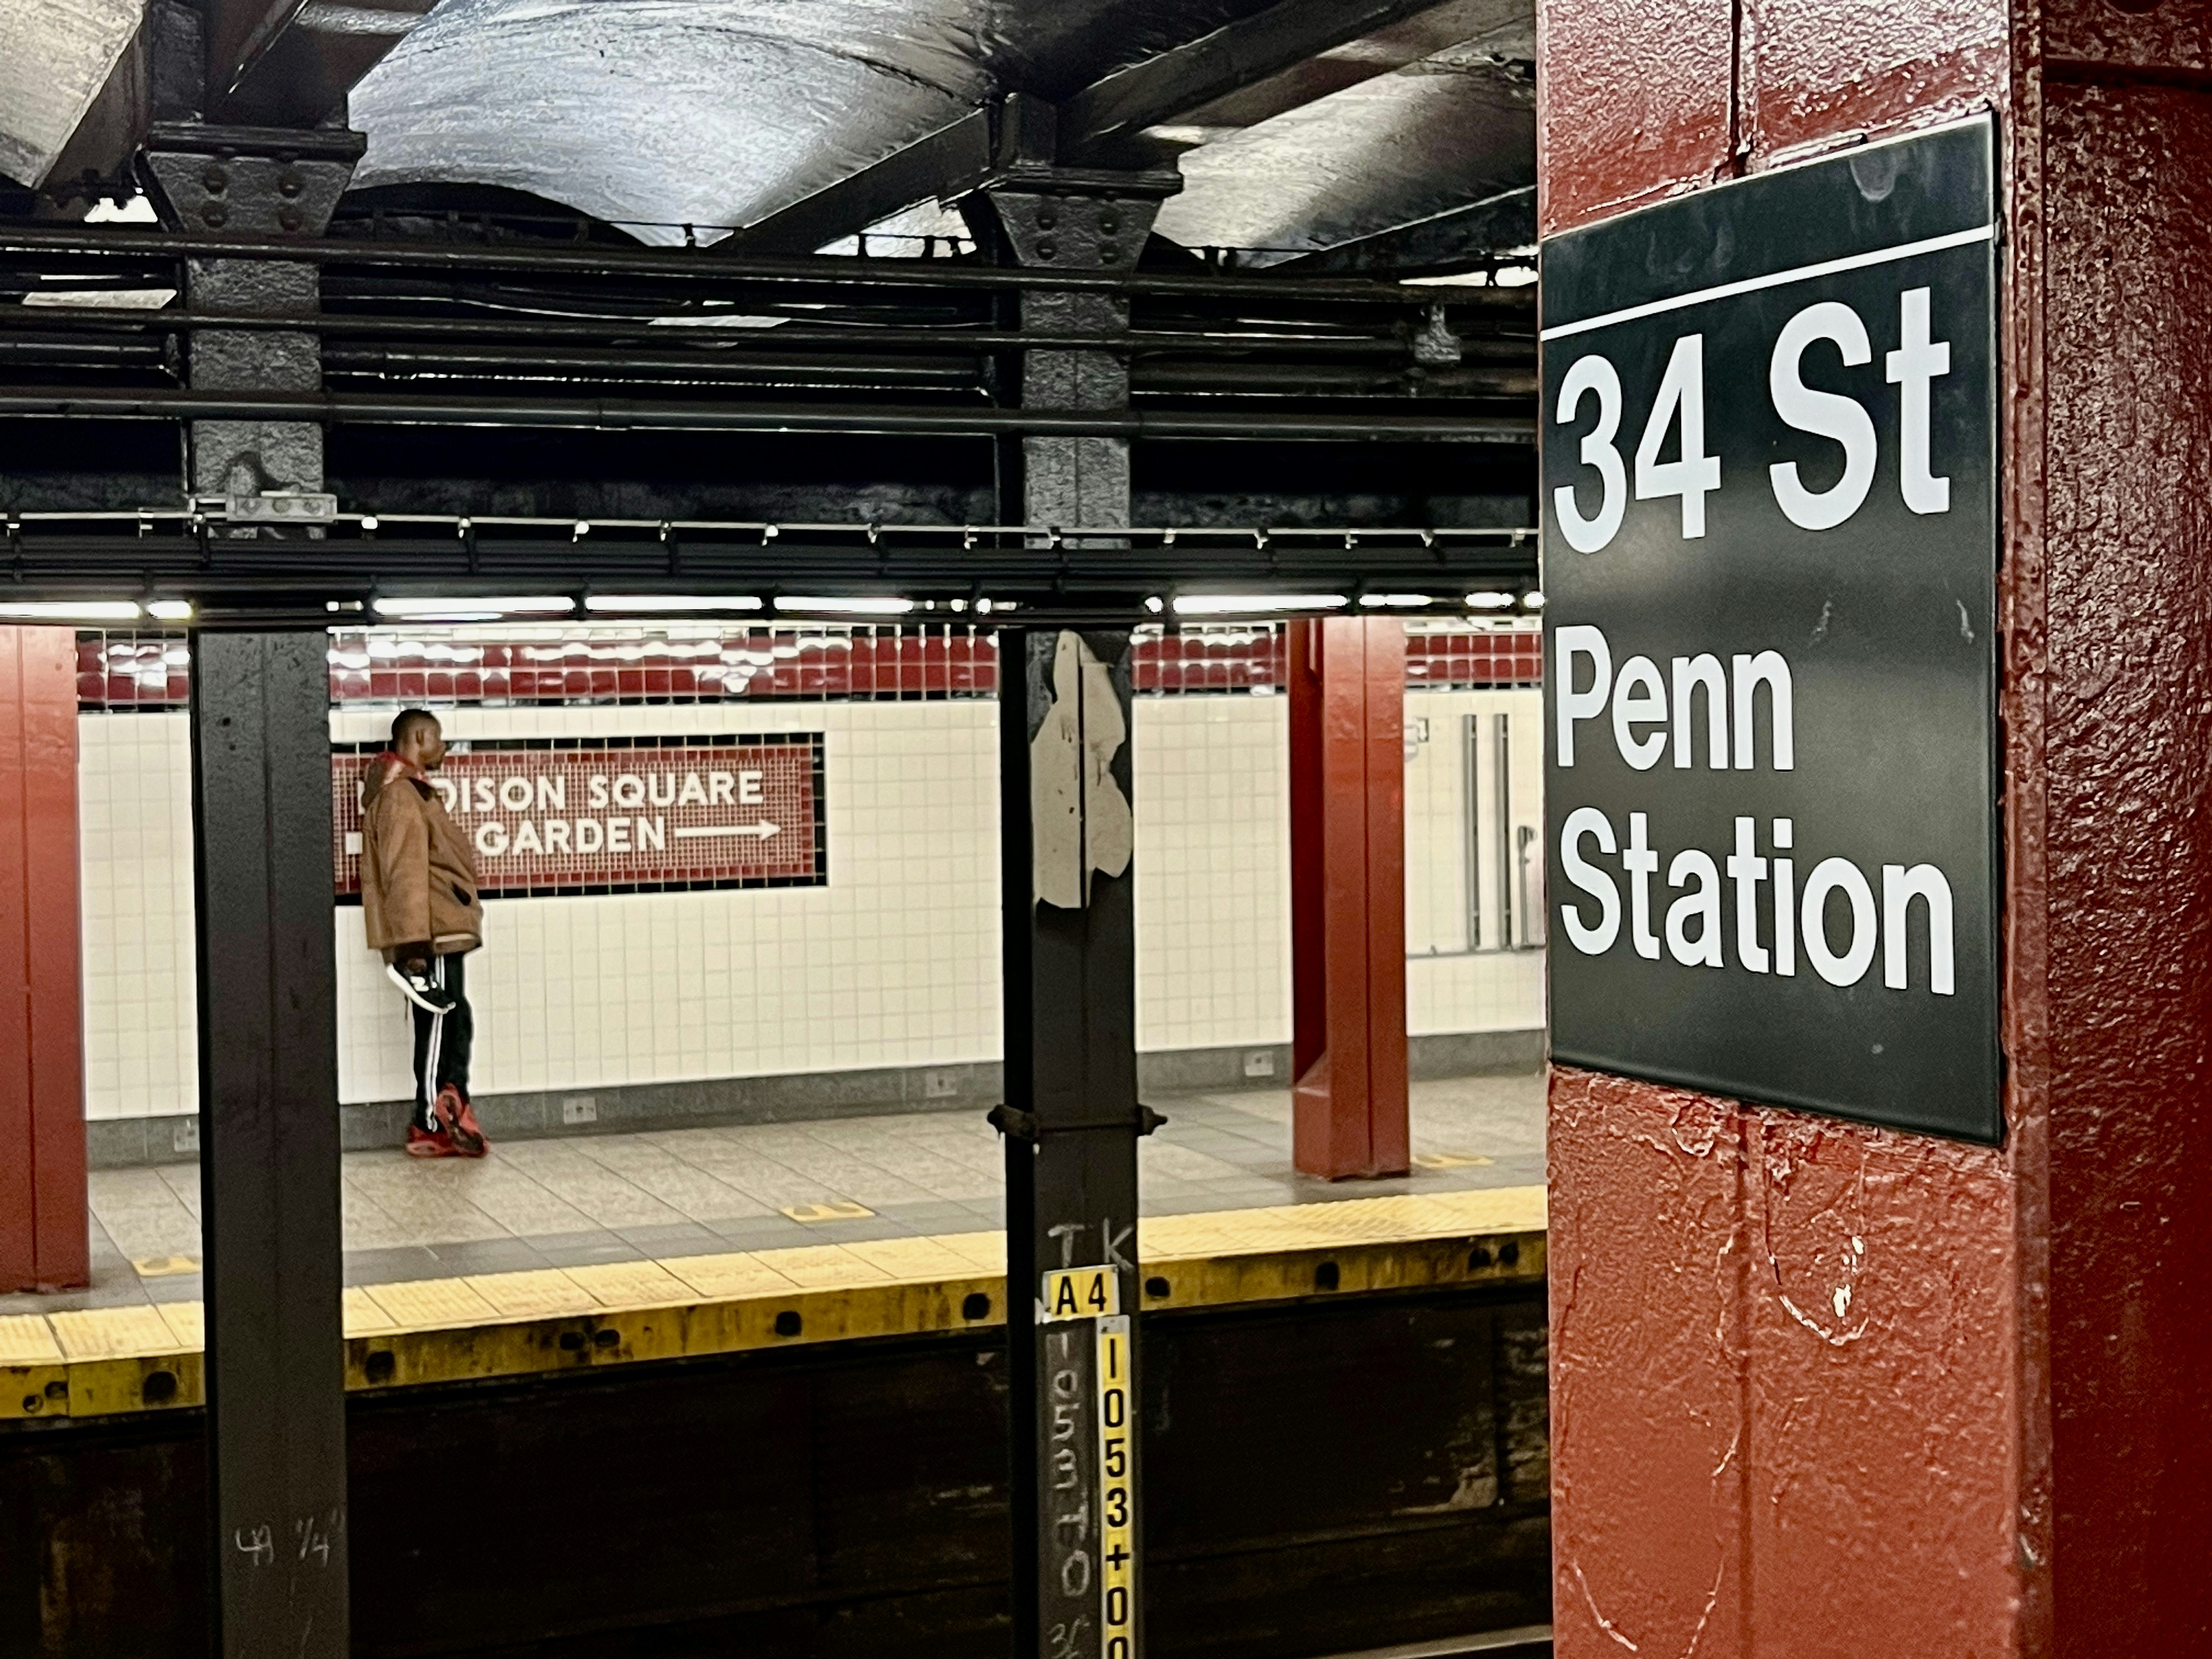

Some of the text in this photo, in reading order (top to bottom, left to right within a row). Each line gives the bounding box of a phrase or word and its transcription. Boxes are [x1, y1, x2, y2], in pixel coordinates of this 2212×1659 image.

[1554, 286, 1950, 554] 34 St
[1555, 624, 1794, 770] Penn
[476, 816, 665, 856] GARDEN
[590, 770, 764, 809] SQUARE
[1560, 806, 1955, 996] Station
